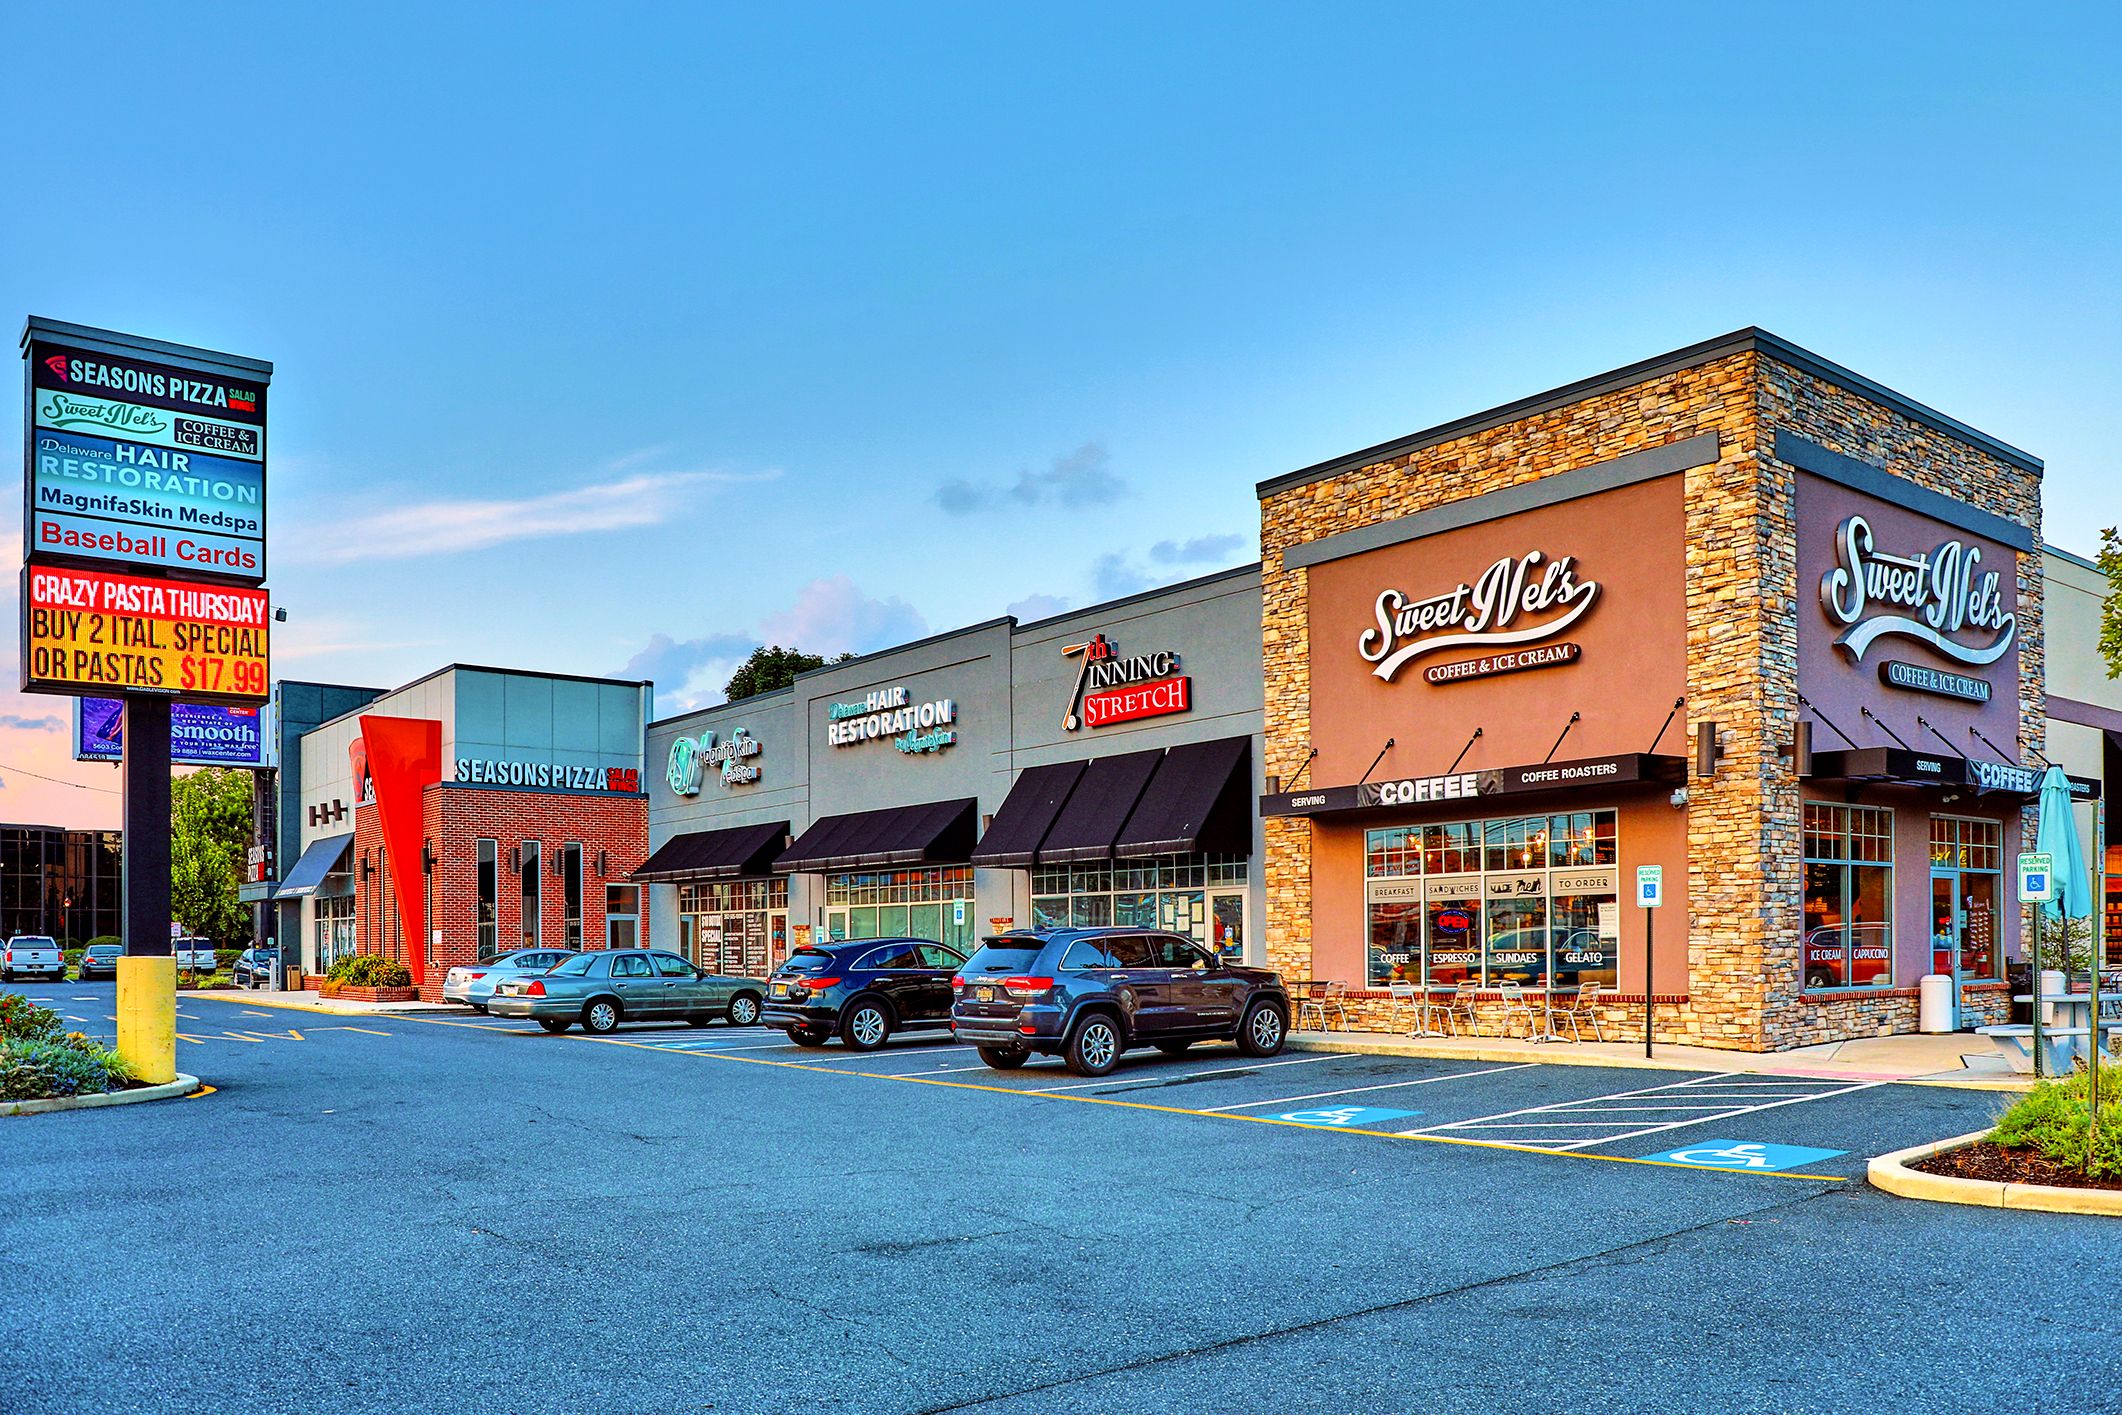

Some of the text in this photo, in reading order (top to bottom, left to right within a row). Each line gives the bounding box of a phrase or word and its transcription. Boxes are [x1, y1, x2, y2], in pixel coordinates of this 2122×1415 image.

[70, 359, 228, 408] SEASONS PIZZA
[229, 388, 256, 402] SALAD
[43, 394, 157, 426] Sweet Nel's
[177, 431, 255, 454] ICE CREAM
[182, 420, 250, 441] COFFEE &
[40, 438, 189, 473] Delaware HAIR
[41, 455, 257, 504] RESTORATION
[41, 486, 258, 532] MagnifaSkin Medspa
[41, 521, 257, 569] Baseball Cards
[1829, 515, 2003, 632] Sweet Nel's
[33, 574, 266, 624] CRAZY PASTA THURSDAY
[1358, 550, 1579, 662] Sweet Nel's
[33, 608, 266, 658] BUY 2 ITAL. SPECIAL
[34, 646, 265, 694] OR PASTAS $17.99
[1088, 651, 1170, 689] INNING
[1428, 645, 1570, 681] COFFEE & ICE CREAM
[1891, 663, 1989, 700] COFFEE & ICE CREAM
[866, 687, 906, 712] HAIR
[1087, 679, 1185, 724] STRETCH
[171, 724, 255, 742] smooth
[828, 699, 952, 746] RESTORATION
[201, 749, 252, 757] waxcenter.com
[457, 758, 608, 790] SEASONS PIZZA
[608, 767, 638, 780] SALAD
[1291, 763, 1618, 808] SERVING COFFEE COFFEE ROASTERS
[1916, 760, 1941, 773] SERVING
[1980, 762, 2032, 793] COFFEE
[2020, 857, 2050, 865] RESERVED
[2023, 865, 2048, 873] PARKING
[1374, 887, 1415, 896] BREAKFAST
[1428, 884, 1479, 895] SANDWICHES
[1558, 879, 1574, 888] TO
[1575, 878, 1608, 888] ORDER
[1438, 914, 1469, 928] OPEN
[1380, 952, 1603, 964] COFFEE ESPRESSO SUNDAES GELATO
[1810, 948, 1888, 960] ICE CREAM CAPPUCCINO
